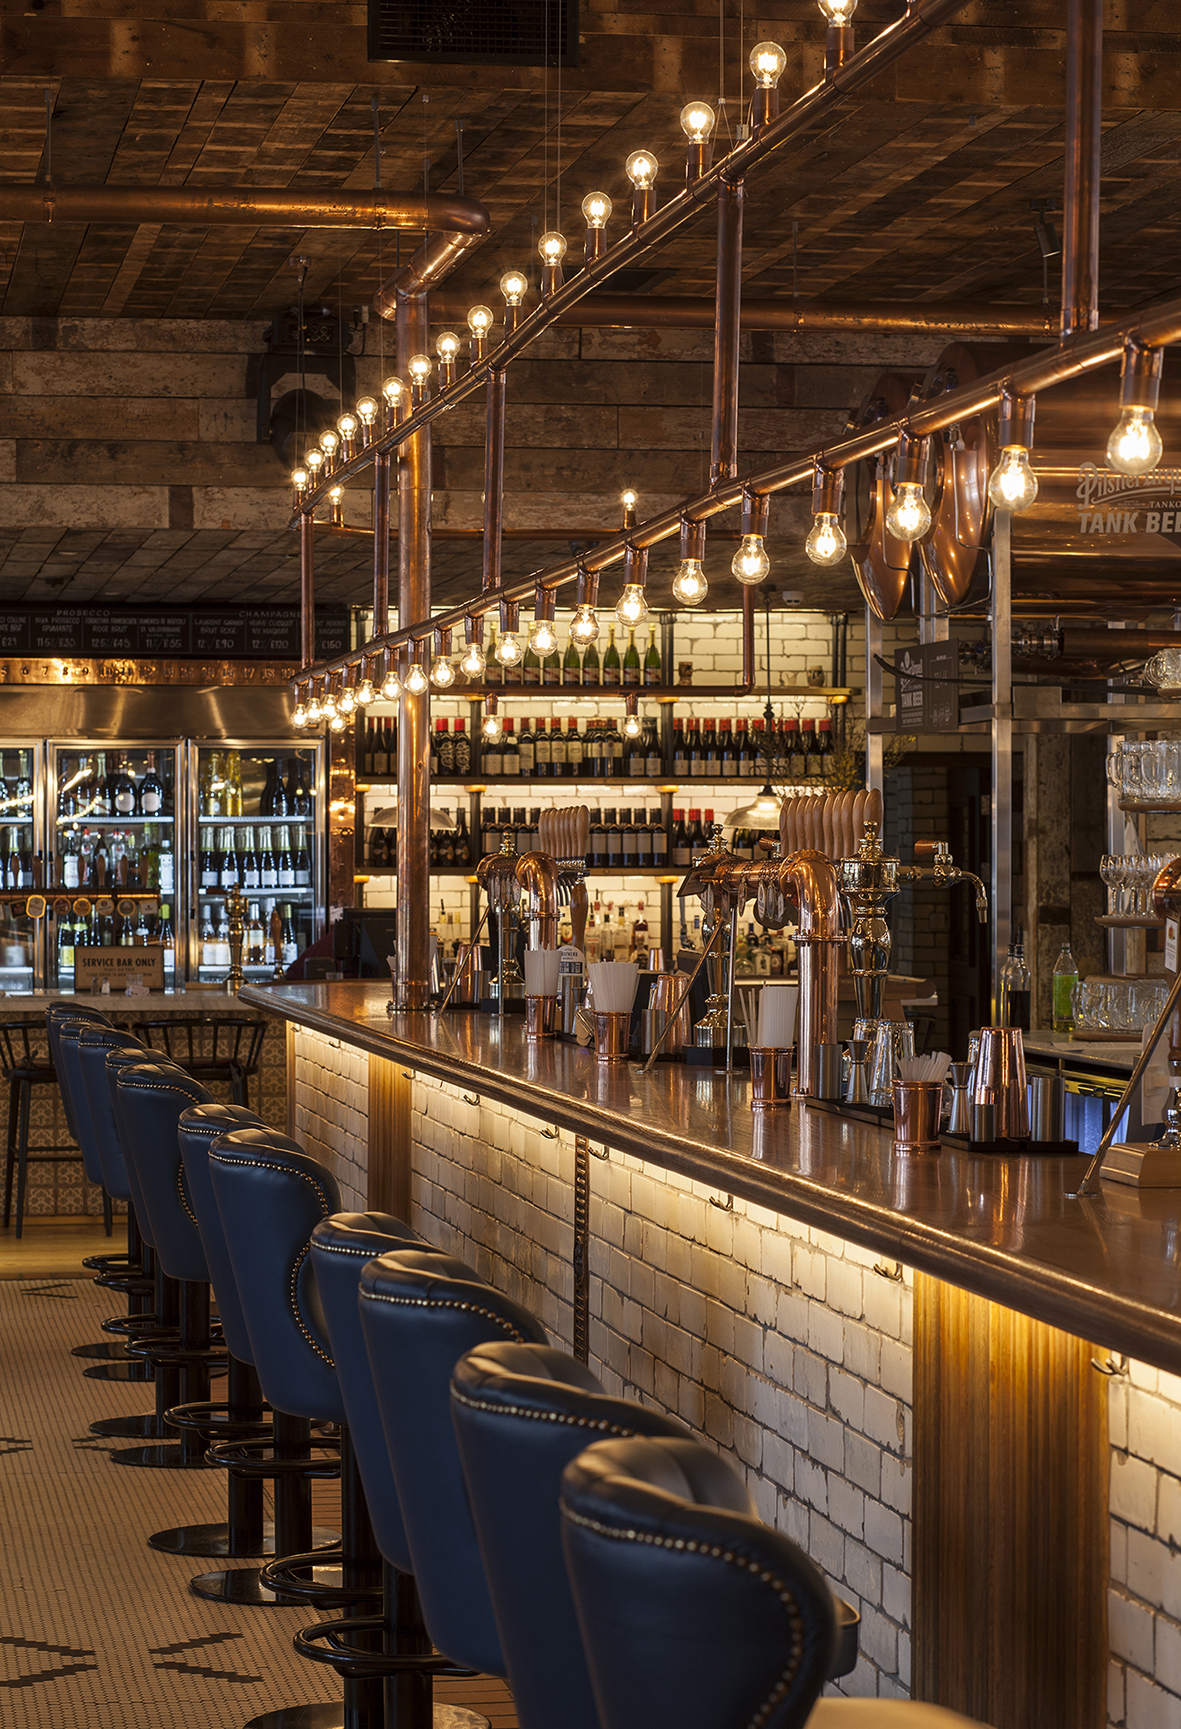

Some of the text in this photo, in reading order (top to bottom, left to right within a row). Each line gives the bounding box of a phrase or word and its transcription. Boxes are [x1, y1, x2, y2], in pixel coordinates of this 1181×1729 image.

[1076, 461, 1140, 510] Pilsner
[1149, 501, 1181, 509] TANKO
[1077, 512, 1139, 534] TANK
[56, 609, 111, 617] PROSECCO
[82, 958, 156, 967] SERVICE BAR ONLY
